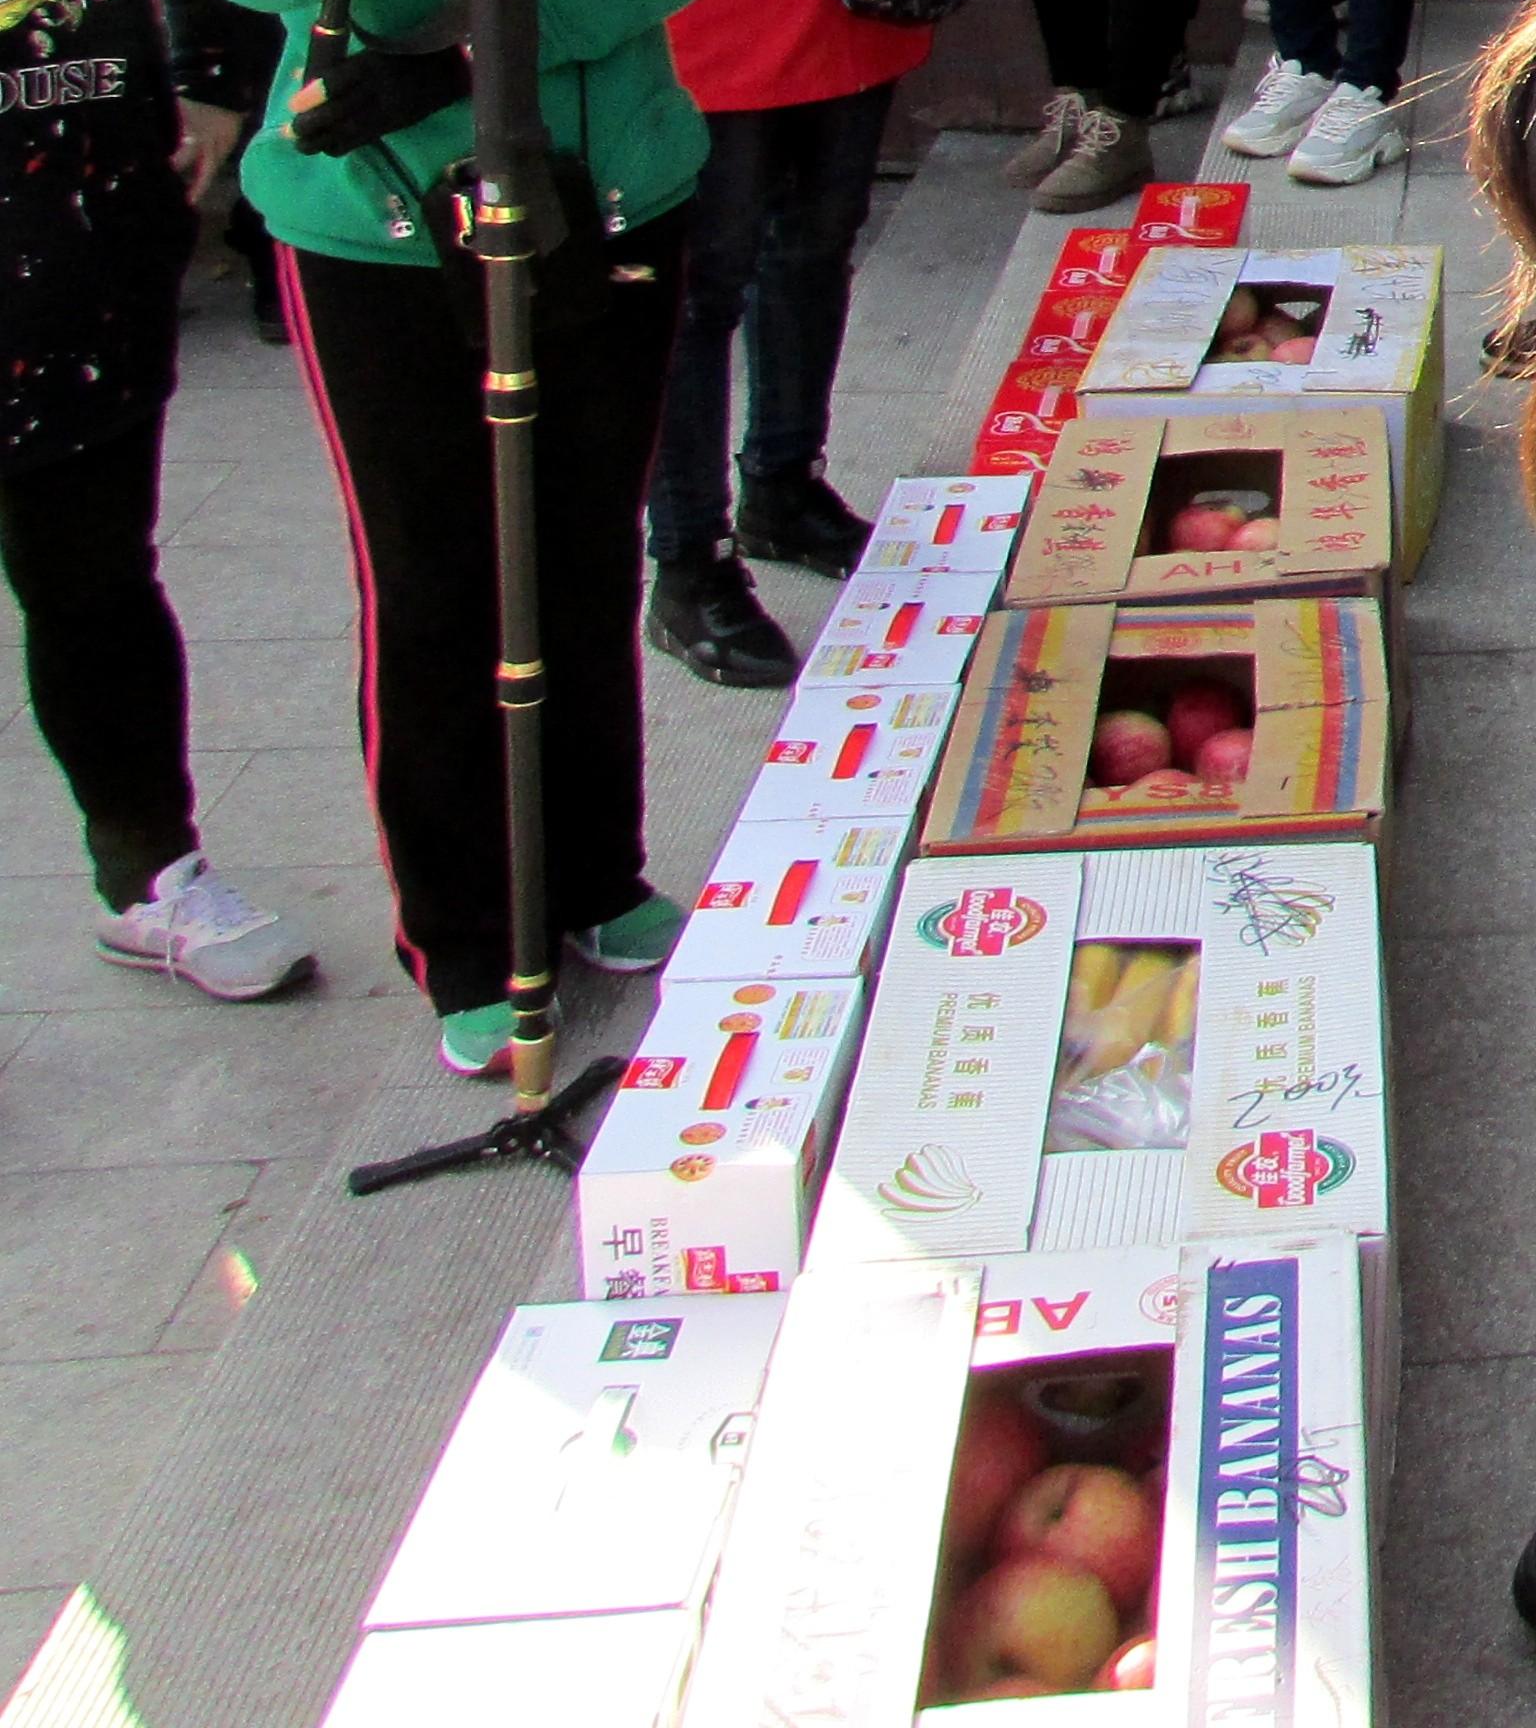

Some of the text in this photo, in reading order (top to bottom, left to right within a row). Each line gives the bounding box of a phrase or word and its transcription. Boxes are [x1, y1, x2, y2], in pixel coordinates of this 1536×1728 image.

[917, 992, 959, 1110] PREMIUM BANANAS
[947, 992, 1001, 1109] 优质香蕉
[1254, 978, 1291, 1095] 优质香蕉
[1299, 975, 1317, 1032] BANANAS
[1216, 1293, 1283, 1529] BANANAS
